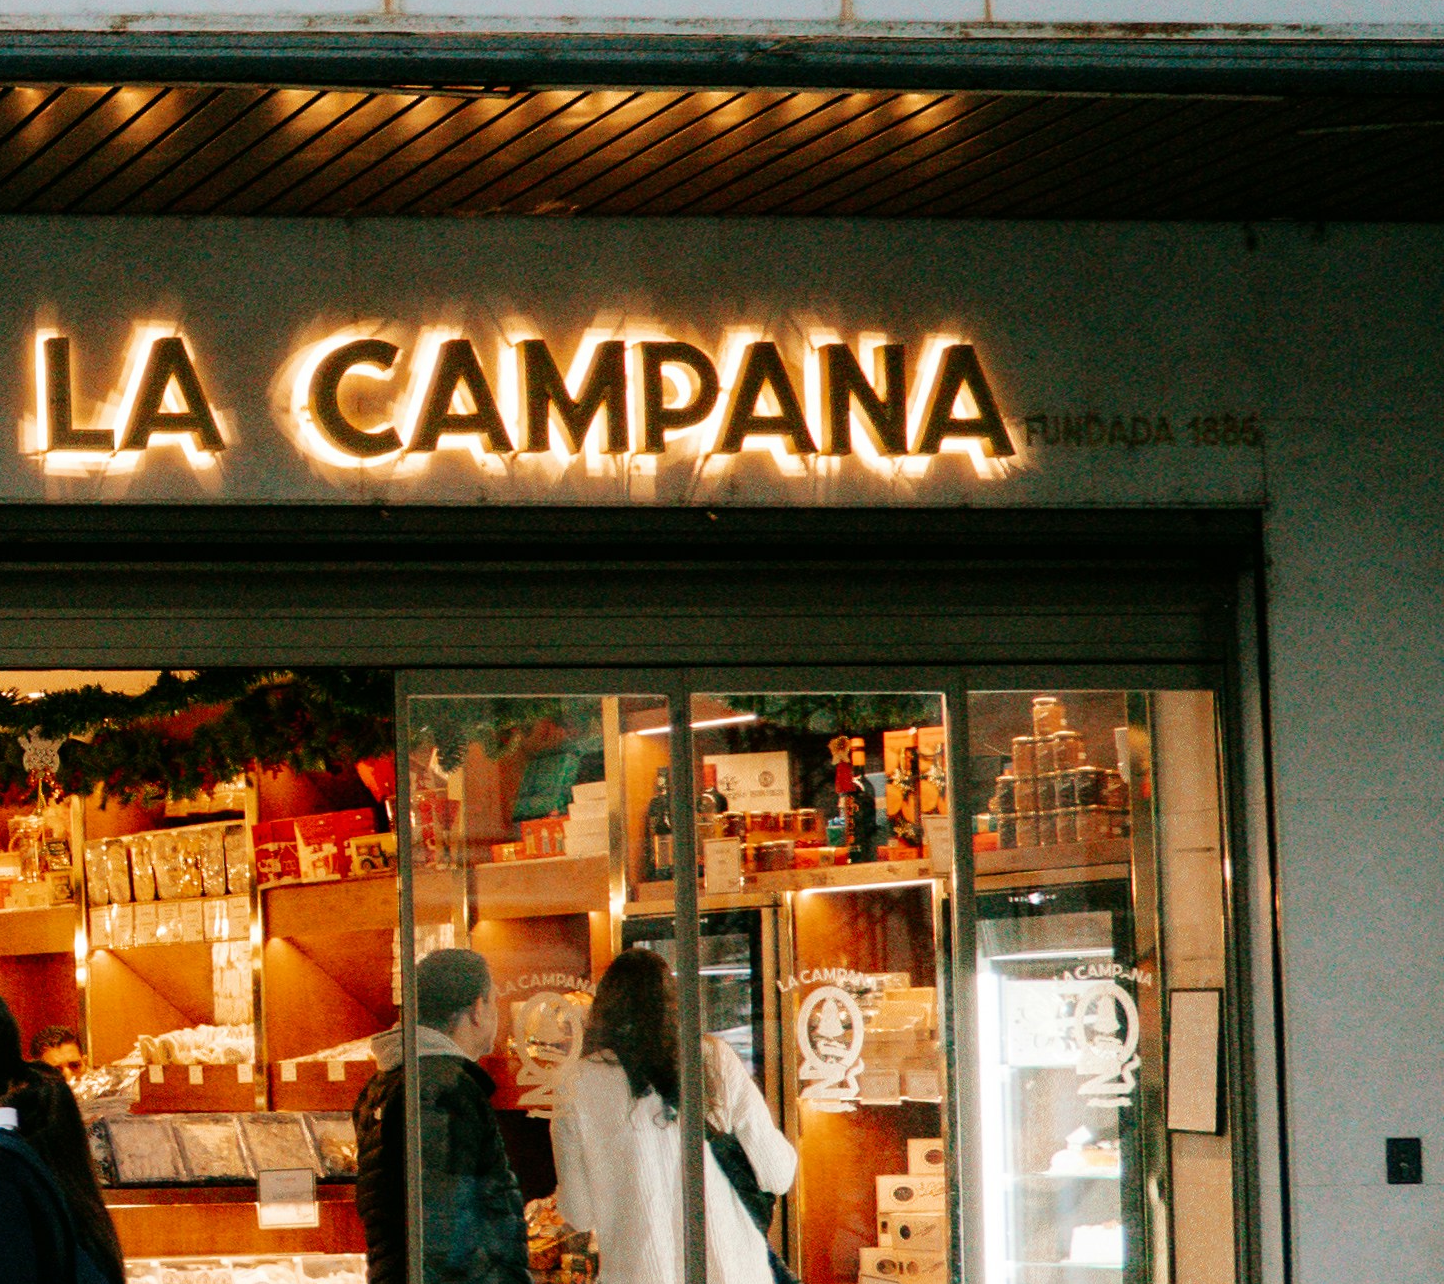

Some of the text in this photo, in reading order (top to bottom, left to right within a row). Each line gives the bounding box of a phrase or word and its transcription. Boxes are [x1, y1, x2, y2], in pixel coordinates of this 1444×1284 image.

[41, 335, 1017, 460] LA CAMPANA
[1023, 412, 1176, 448] FUNDADA
